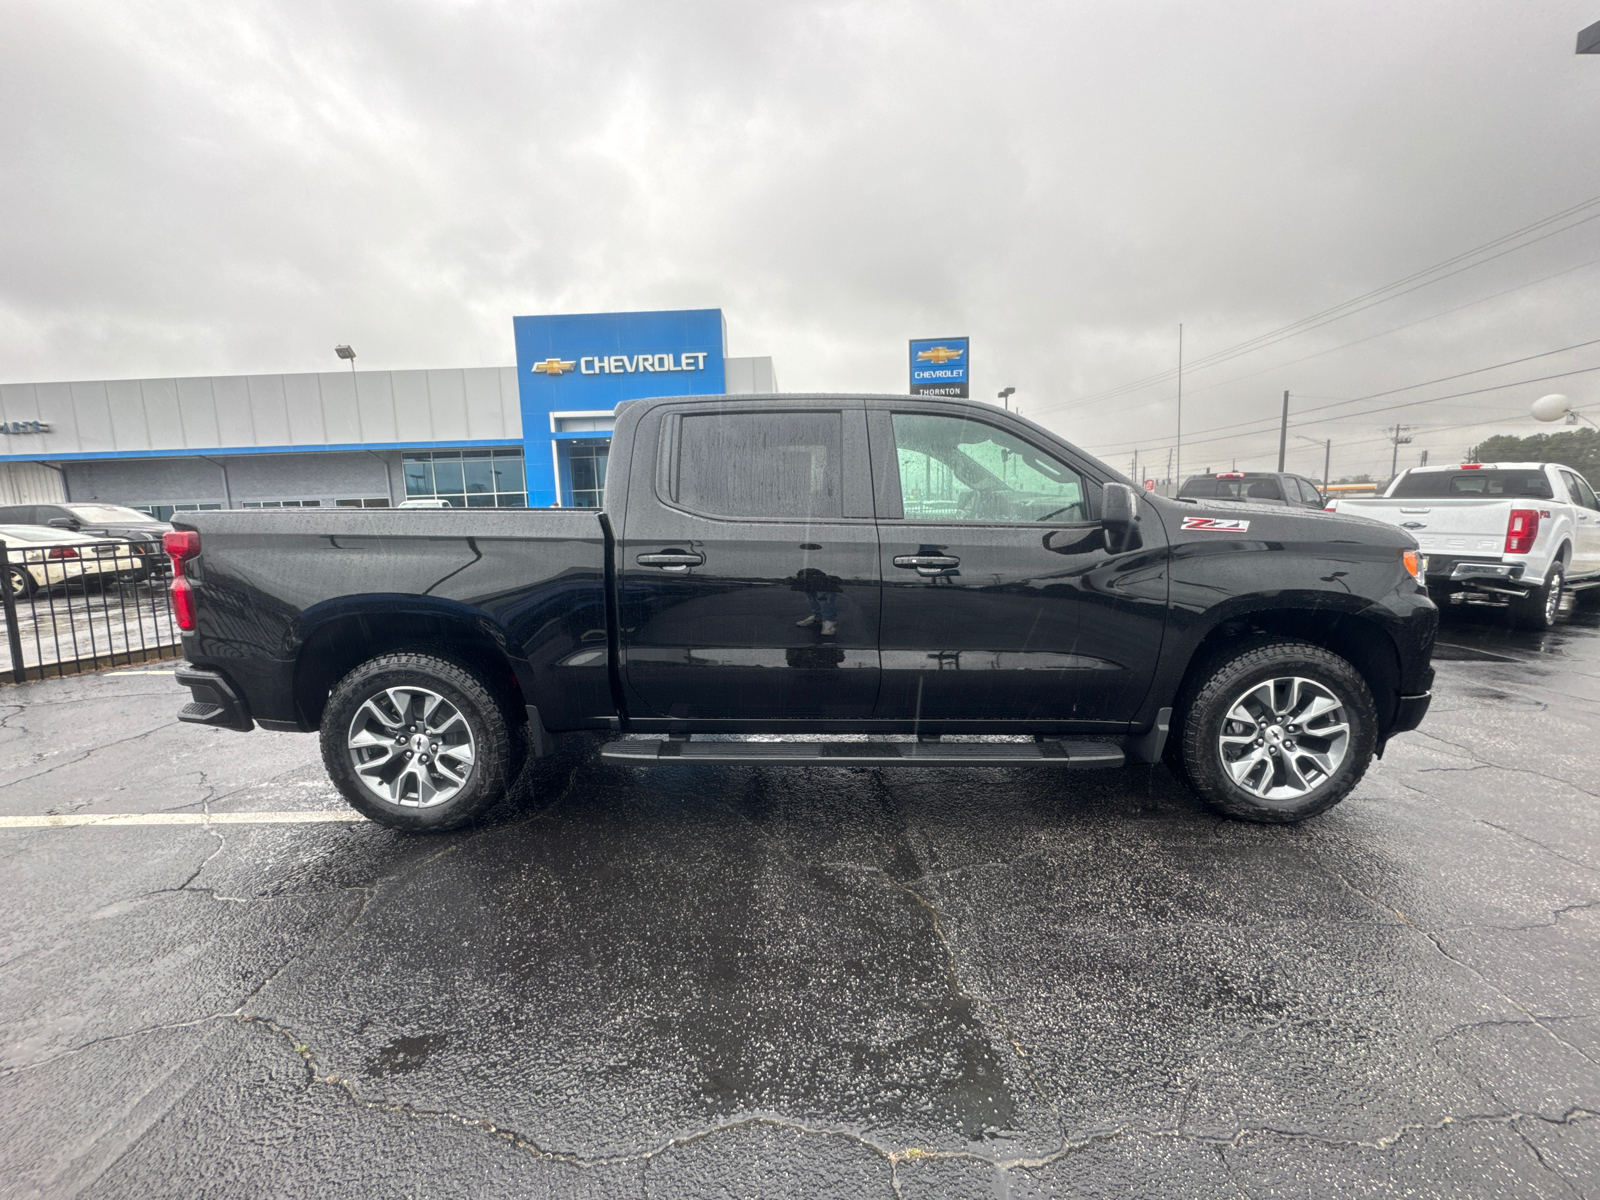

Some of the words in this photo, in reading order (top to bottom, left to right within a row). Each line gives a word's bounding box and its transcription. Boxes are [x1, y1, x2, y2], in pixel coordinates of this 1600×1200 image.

[580, 353, 708, 375] CHEVROLET
[914, 369, 964, 379] CHEVROLET
[919, 388, 961, 396] THORNTON
[1, 420, 41, 434] ARTS
[1180, 516, 1251, 533] Z71
